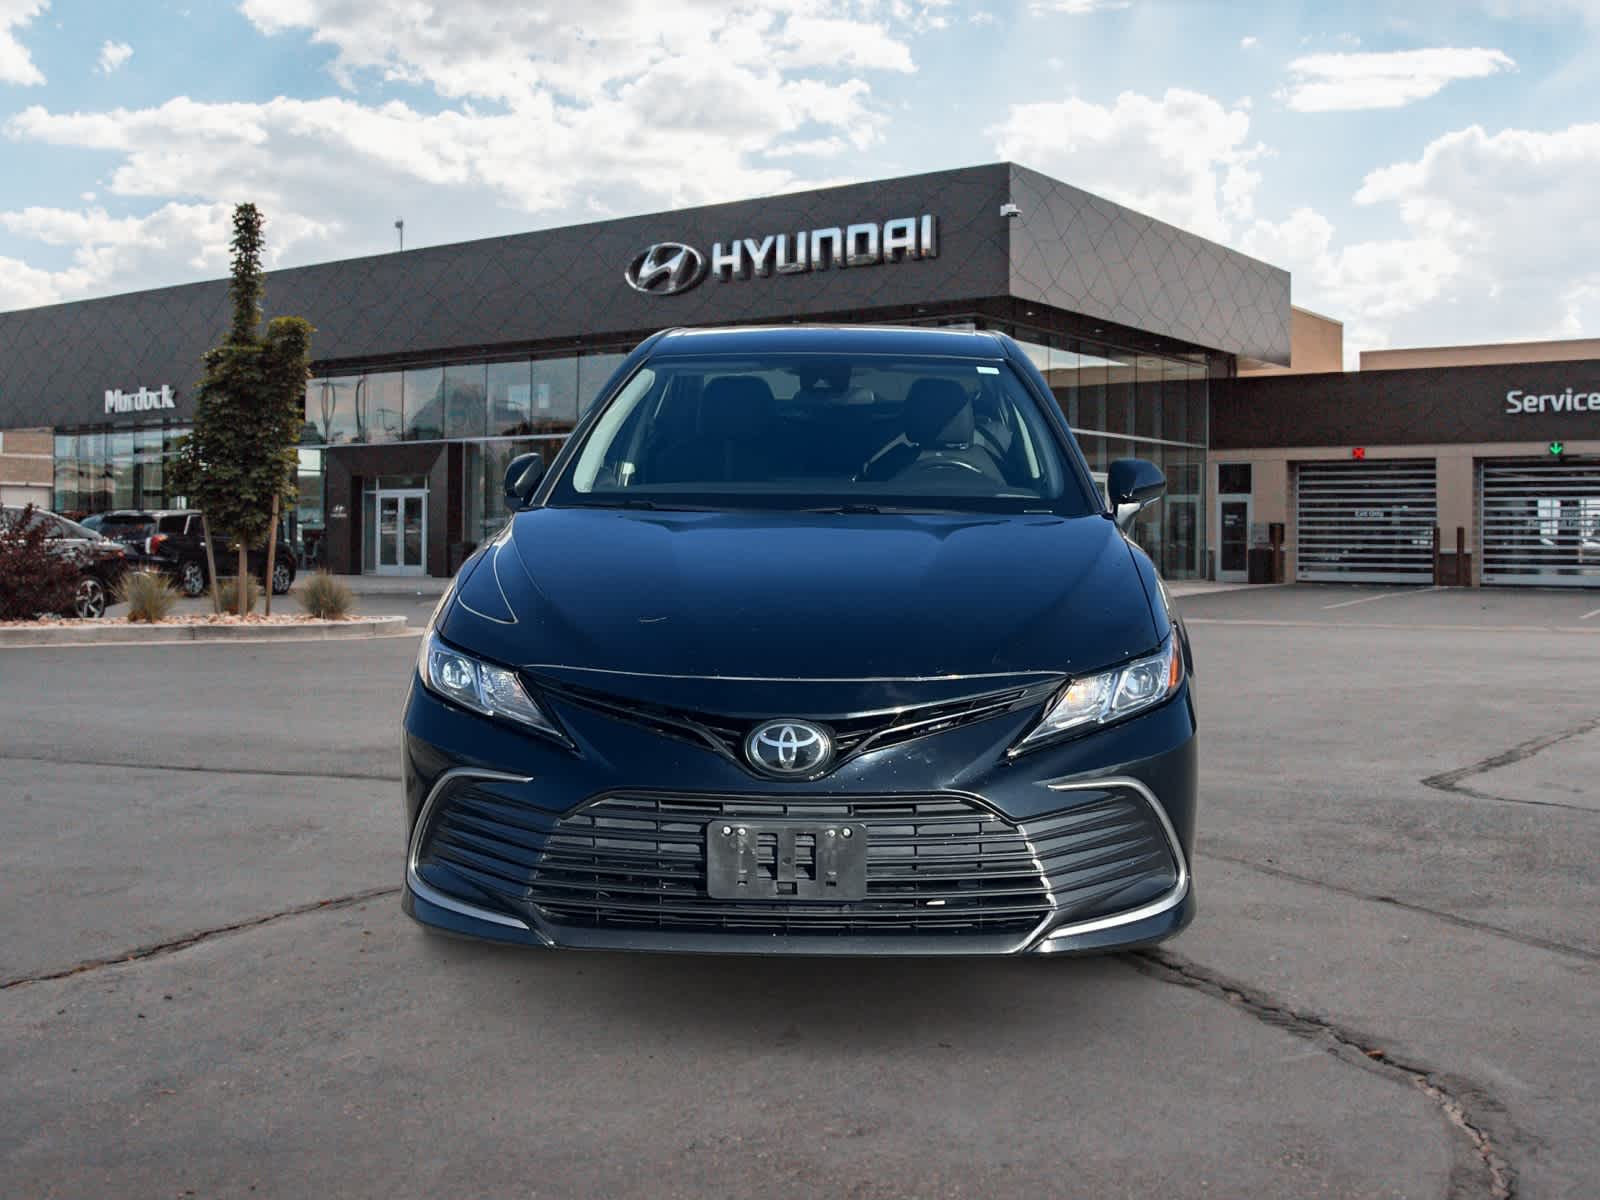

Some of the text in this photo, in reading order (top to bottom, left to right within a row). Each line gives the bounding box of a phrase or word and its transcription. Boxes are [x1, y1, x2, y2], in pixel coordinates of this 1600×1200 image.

[711, 213, 938, 282] HYUNDAI
[104, 384, 176, 414] Murdock
[1505, 387, 1600, 414] Service
